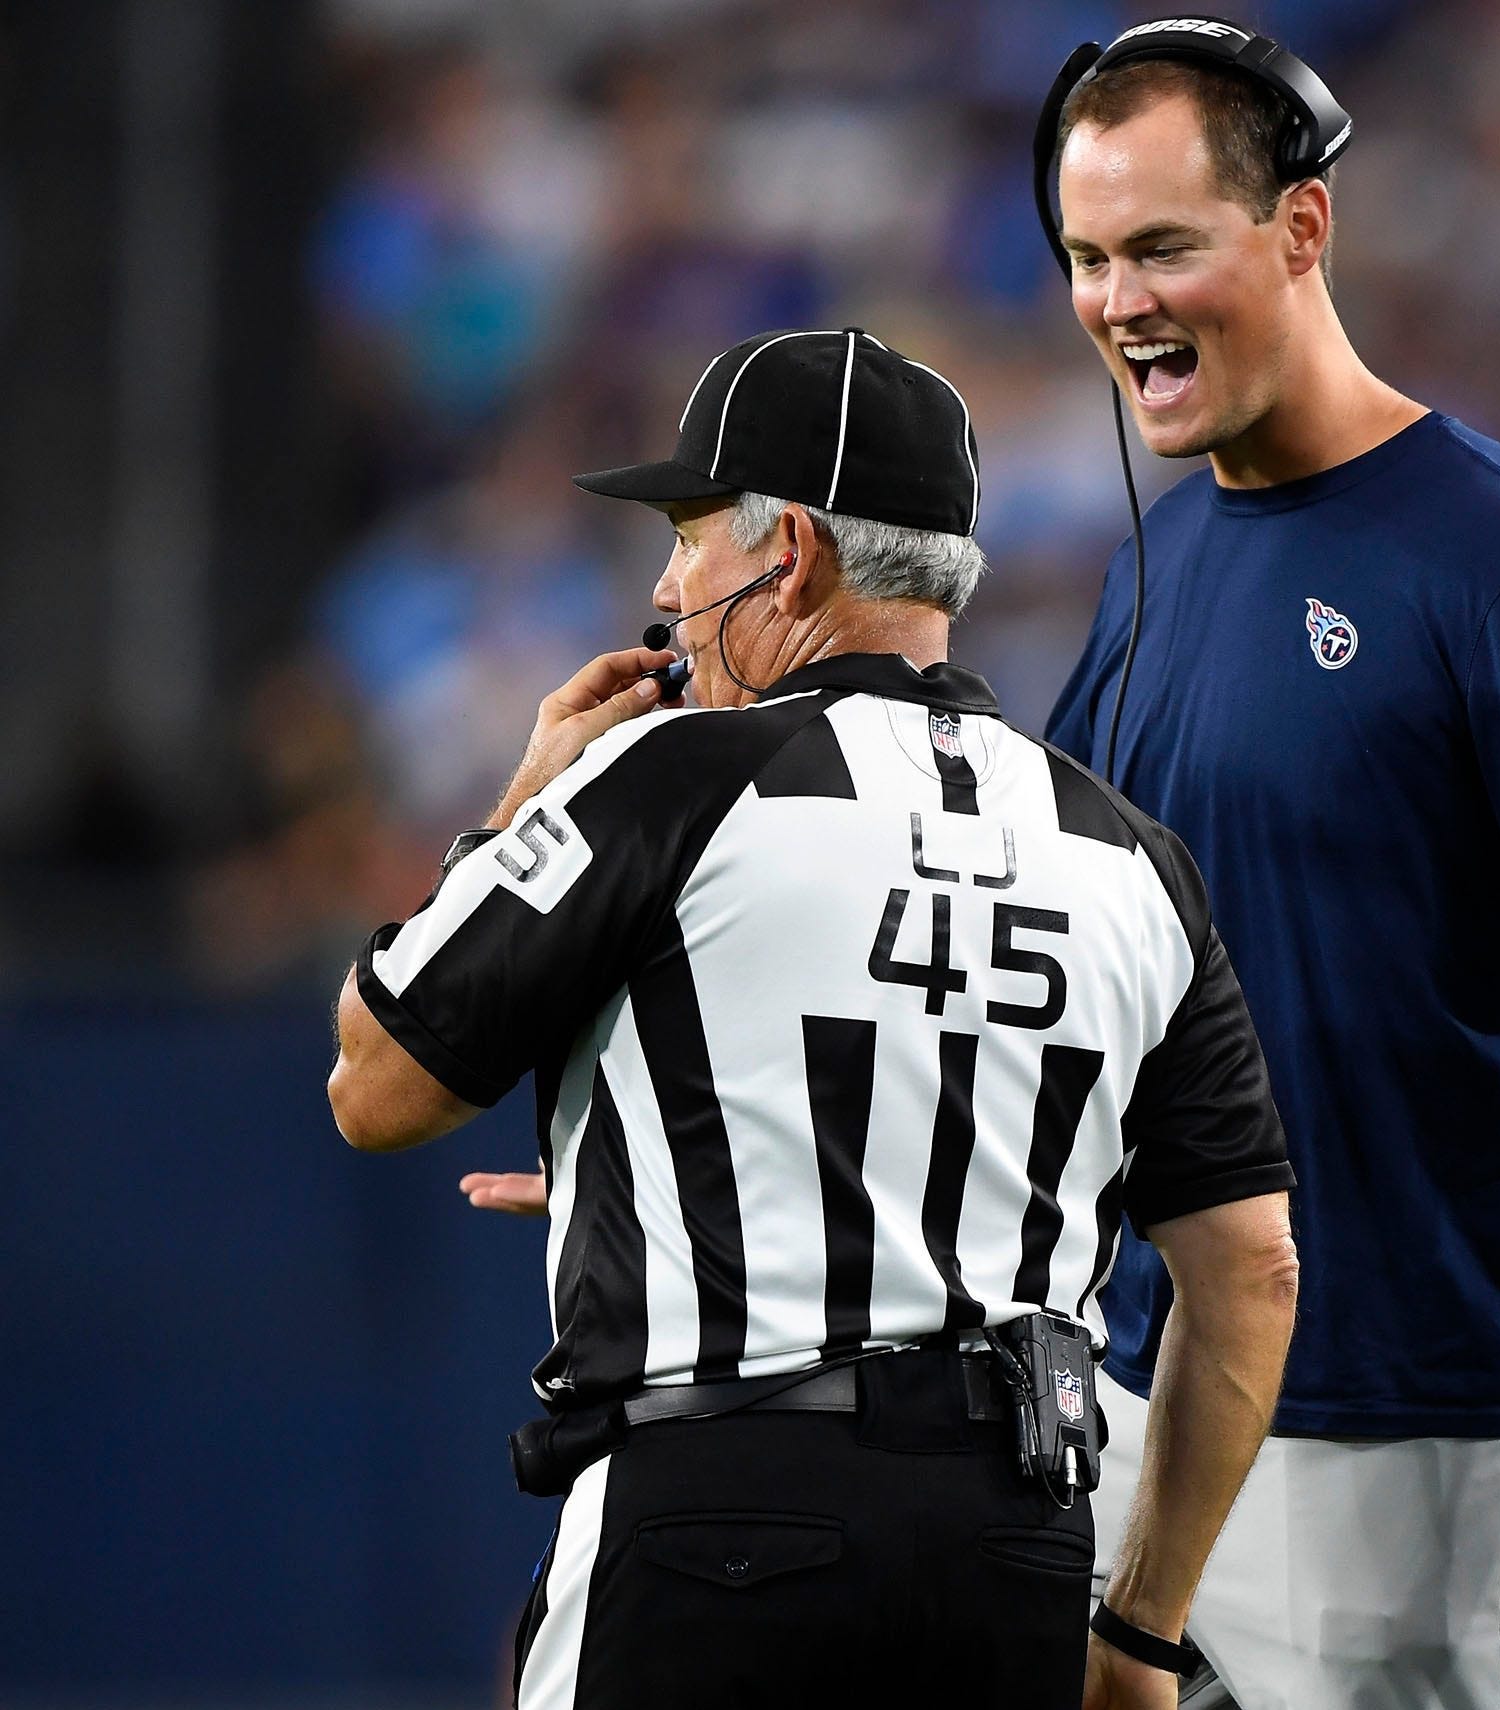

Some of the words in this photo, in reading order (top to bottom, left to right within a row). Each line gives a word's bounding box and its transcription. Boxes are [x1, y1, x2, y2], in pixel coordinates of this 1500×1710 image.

[1110, 18, 1249, 46] BOSE
[933, 730, 962, 753] NFL
[494, 806, 571, 884] 5
[909, 811, 1018, 890] LJ
[867, 887, 1070, 1031] 45
[1060, 1390, 1080, 1414] NFL
